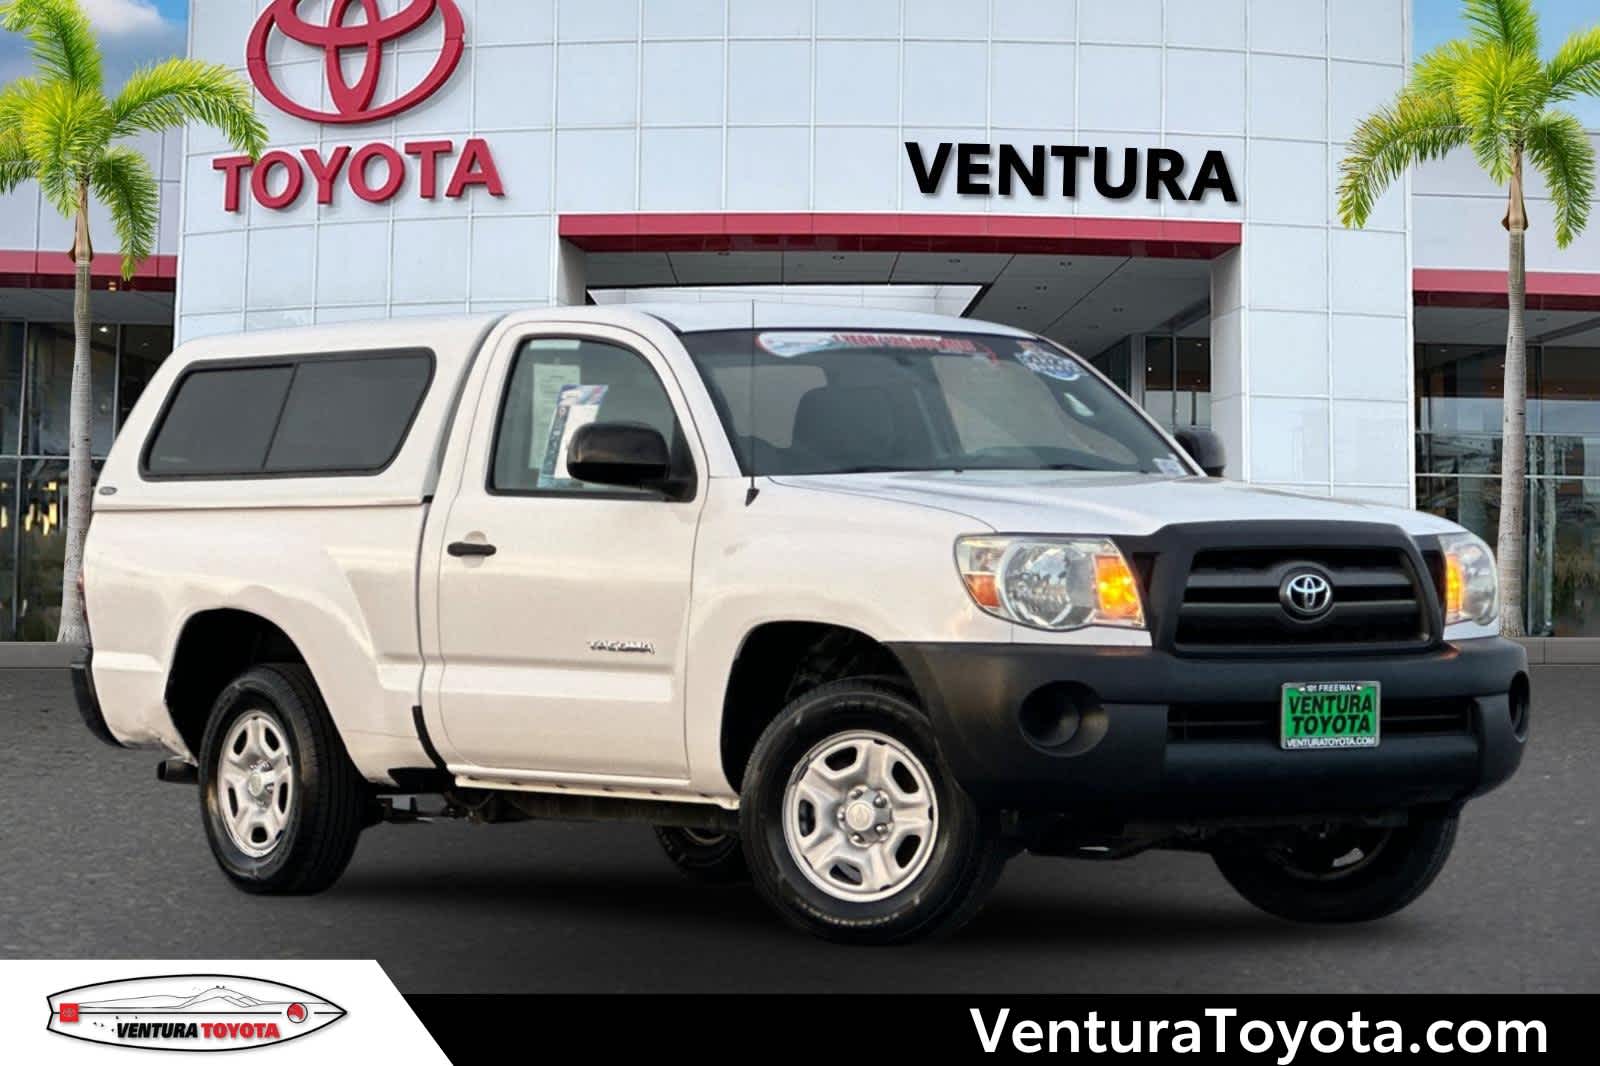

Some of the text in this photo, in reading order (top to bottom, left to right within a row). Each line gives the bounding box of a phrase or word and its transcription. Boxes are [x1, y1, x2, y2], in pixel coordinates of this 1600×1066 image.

[213, 138, 505, 213] TOYOTA
[904, 141, 1239, 203] VENTURA
[1318, 684, 1356, 692] FREEWAY
[1288, 694, 1373, 715] VENTURA
[1292, 714, 1371, 735] TOYOTA
[1286, 736, 1375, 748] VENTURATOYOTA.COM
